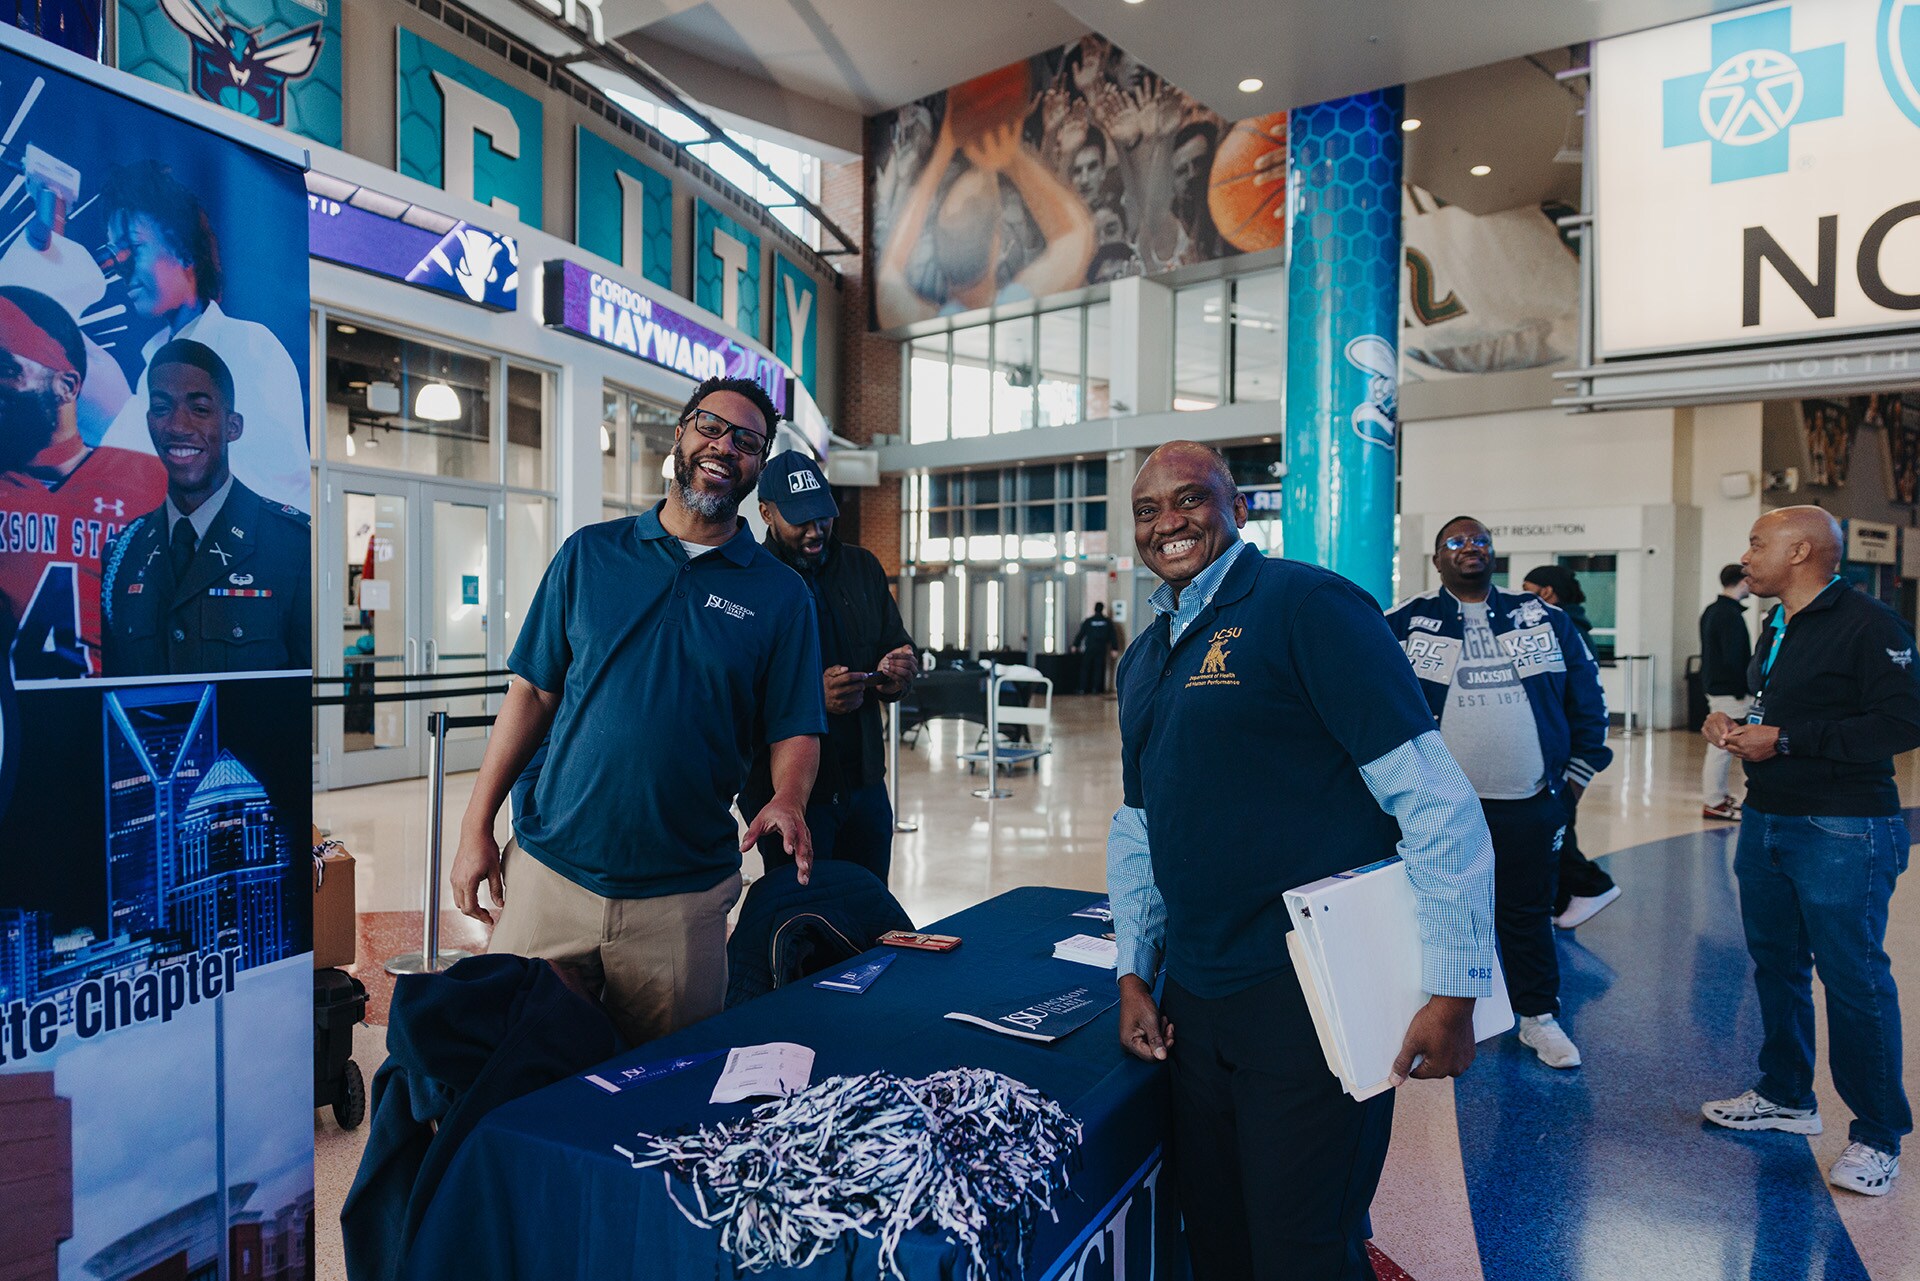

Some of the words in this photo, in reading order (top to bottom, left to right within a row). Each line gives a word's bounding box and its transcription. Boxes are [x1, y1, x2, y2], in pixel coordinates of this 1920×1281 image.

[308, 196, 341, 216] TIP
[590, 273, 651, 319] GORDON
[590, 296, 726, 379] HAYWARD
[1768, 350, 1909, 379] NORTH
[1511, 523, 1585, 537] RESOLUTION
[704, 593, 728, 609] JSU
[1209, 627, 1243, 643] JCSU
[1467, 668, 1513, 684] JACKSON
[75, 946, 242, 1039] Chapter
[999, 1006, 1048, 1030] JSU
